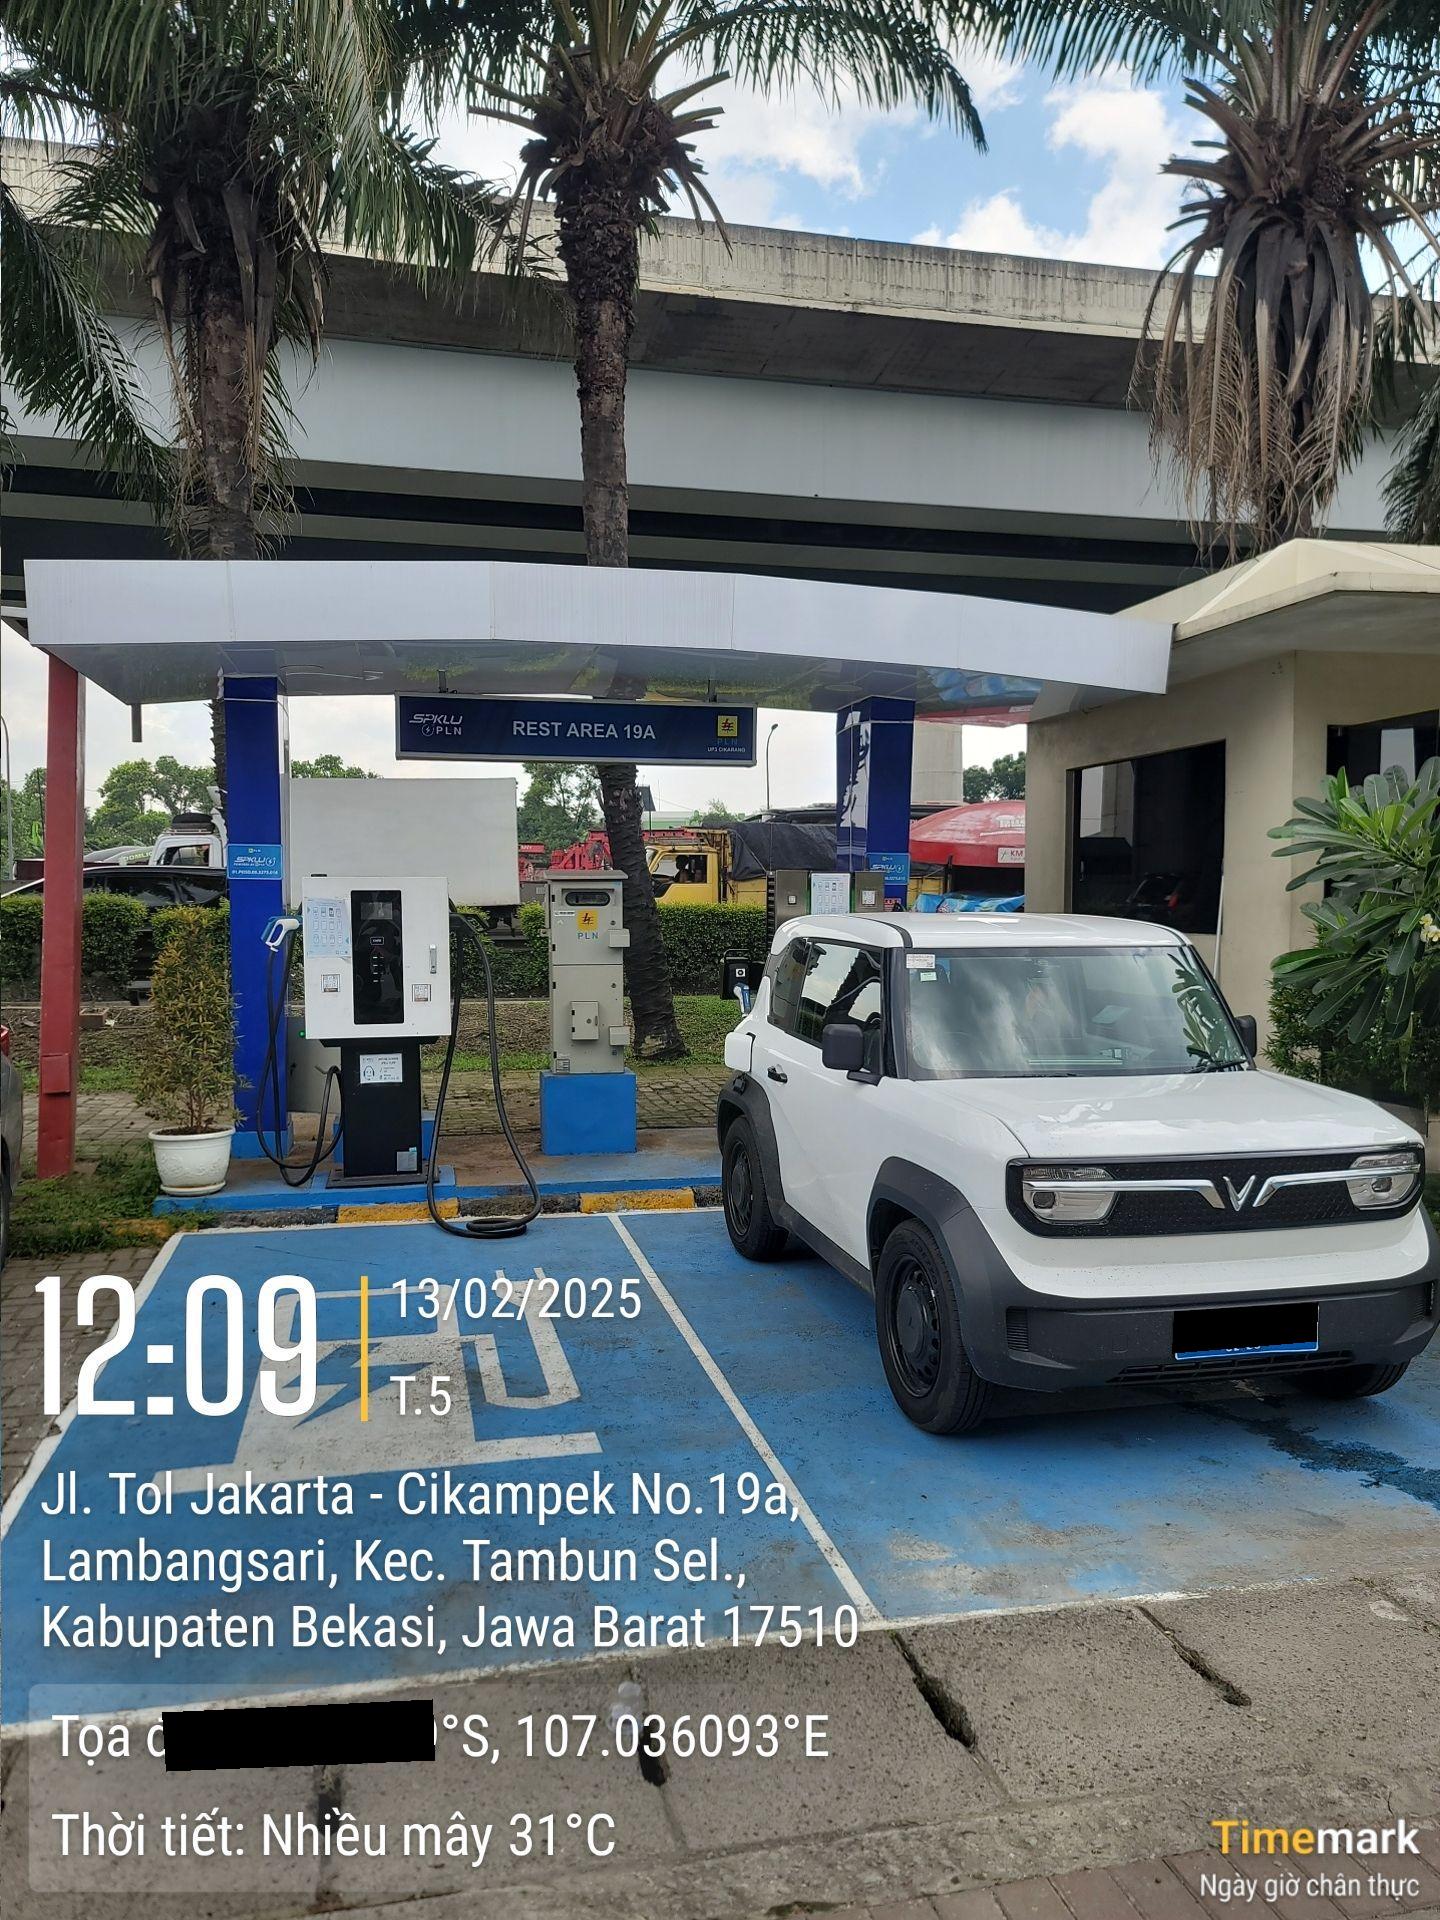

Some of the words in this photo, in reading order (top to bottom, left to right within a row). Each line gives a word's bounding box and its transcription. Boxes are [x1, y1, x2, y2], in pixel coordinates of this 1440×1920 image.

[409, 713, 463, 725] SPKLU
[436, 726, 462, 735] PLN
[512, 720, 562, 737] REST
[566, 722, 618, 739] AREA
[623, 724, 656, 739] 19A
[577, 932, 599, 940] PLN
